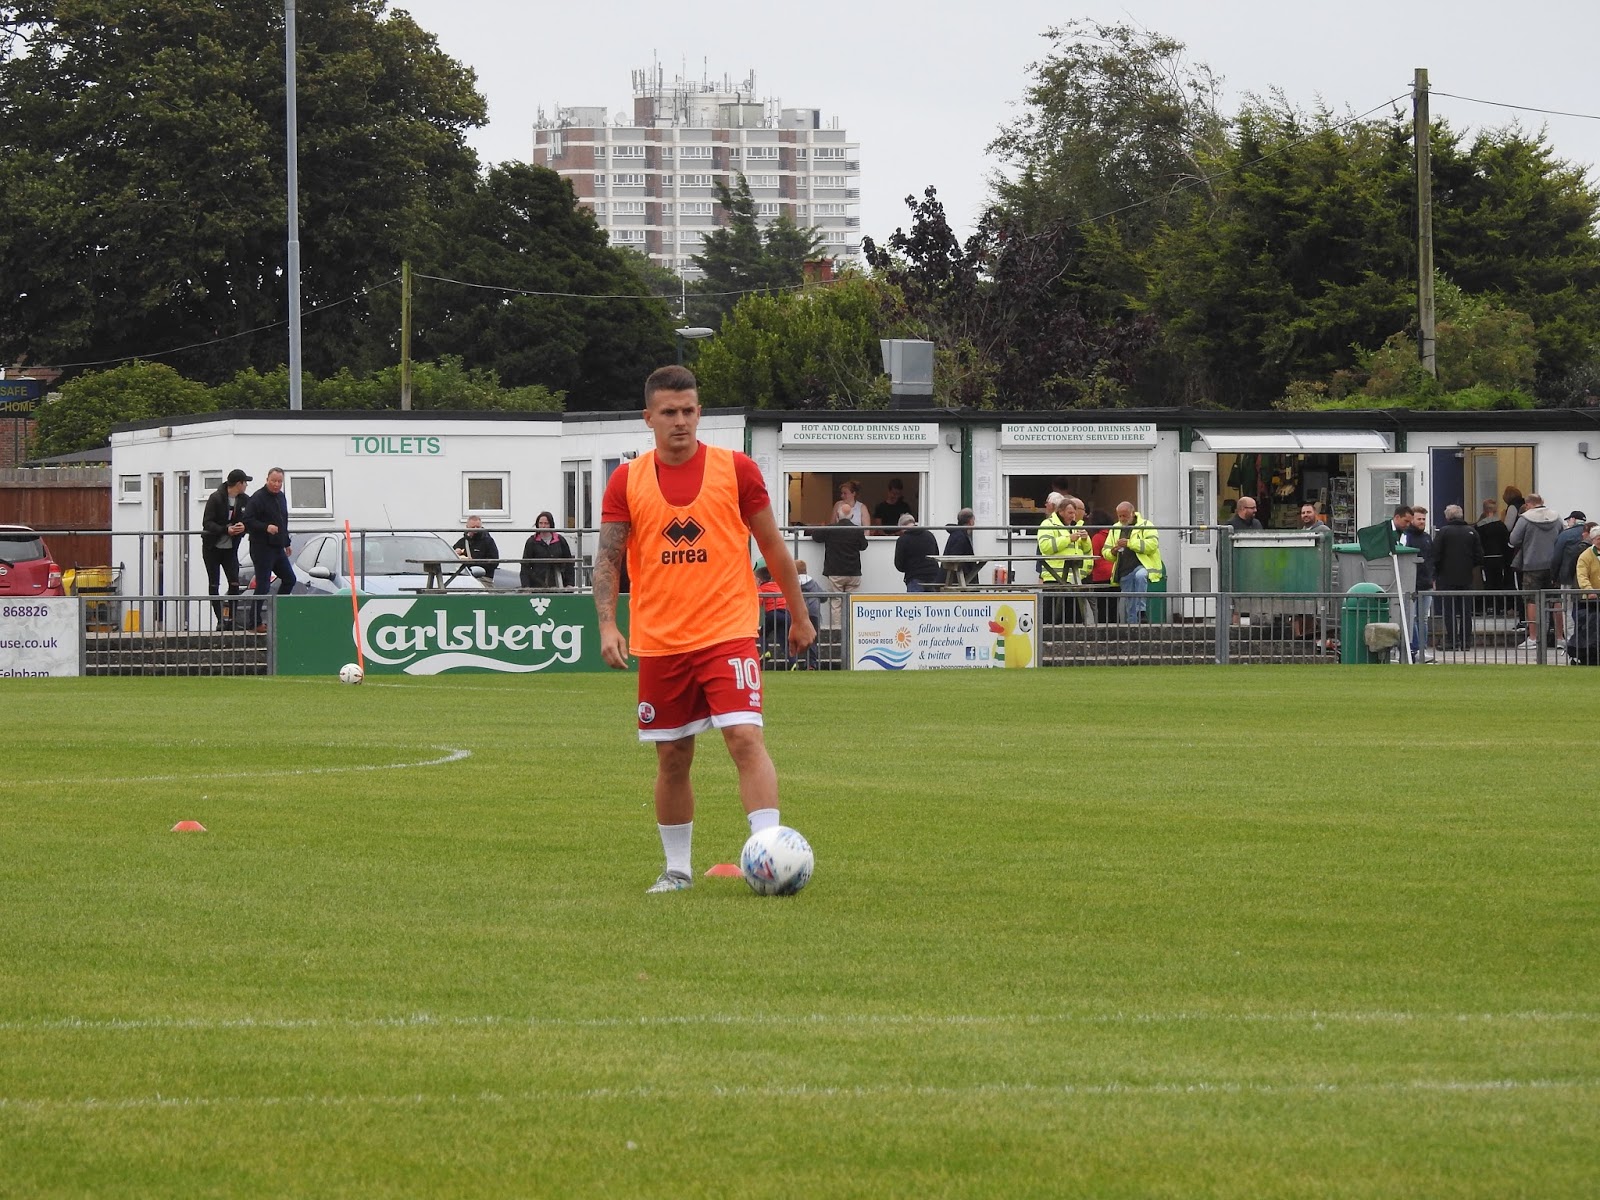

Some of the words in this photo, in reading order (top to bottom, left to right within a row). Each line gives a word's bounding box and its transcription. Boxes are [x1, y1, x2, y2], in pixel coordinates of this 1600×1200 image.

[0, 386, 28, 396] SAFE
[5, 401, 36, 412] HOME
[801, 424, 819, 432] HOT
[821, 424, 840, 432] AND
[841, 424, 864, 432] COLD
[866, 424, 900, 432] DRINKS
[902, 424, 920, 432] AND
[350, 436, 441, 454] TOILETS
[3, 606, 48, 617] 868826
[857, 606, 893, 620] Bognor
[895, 605, 922, 620] Regis
[924, 606, 951, 617] Town
[953, 605, 992, 617] Council
[352, 598, 584, 669] Carlsberg
[917, 623, 940, 636] follow
[941, 623, 955, 633] the
[957, 623, 979, 633] ducks
[0, 637, 57, 648] use.co.uk
[929, 637, 964, 649] facebook
[918, 651, 925, 660] &
[927, 650, 952, 660] twitter
[728, 657, 761, 690] 10
